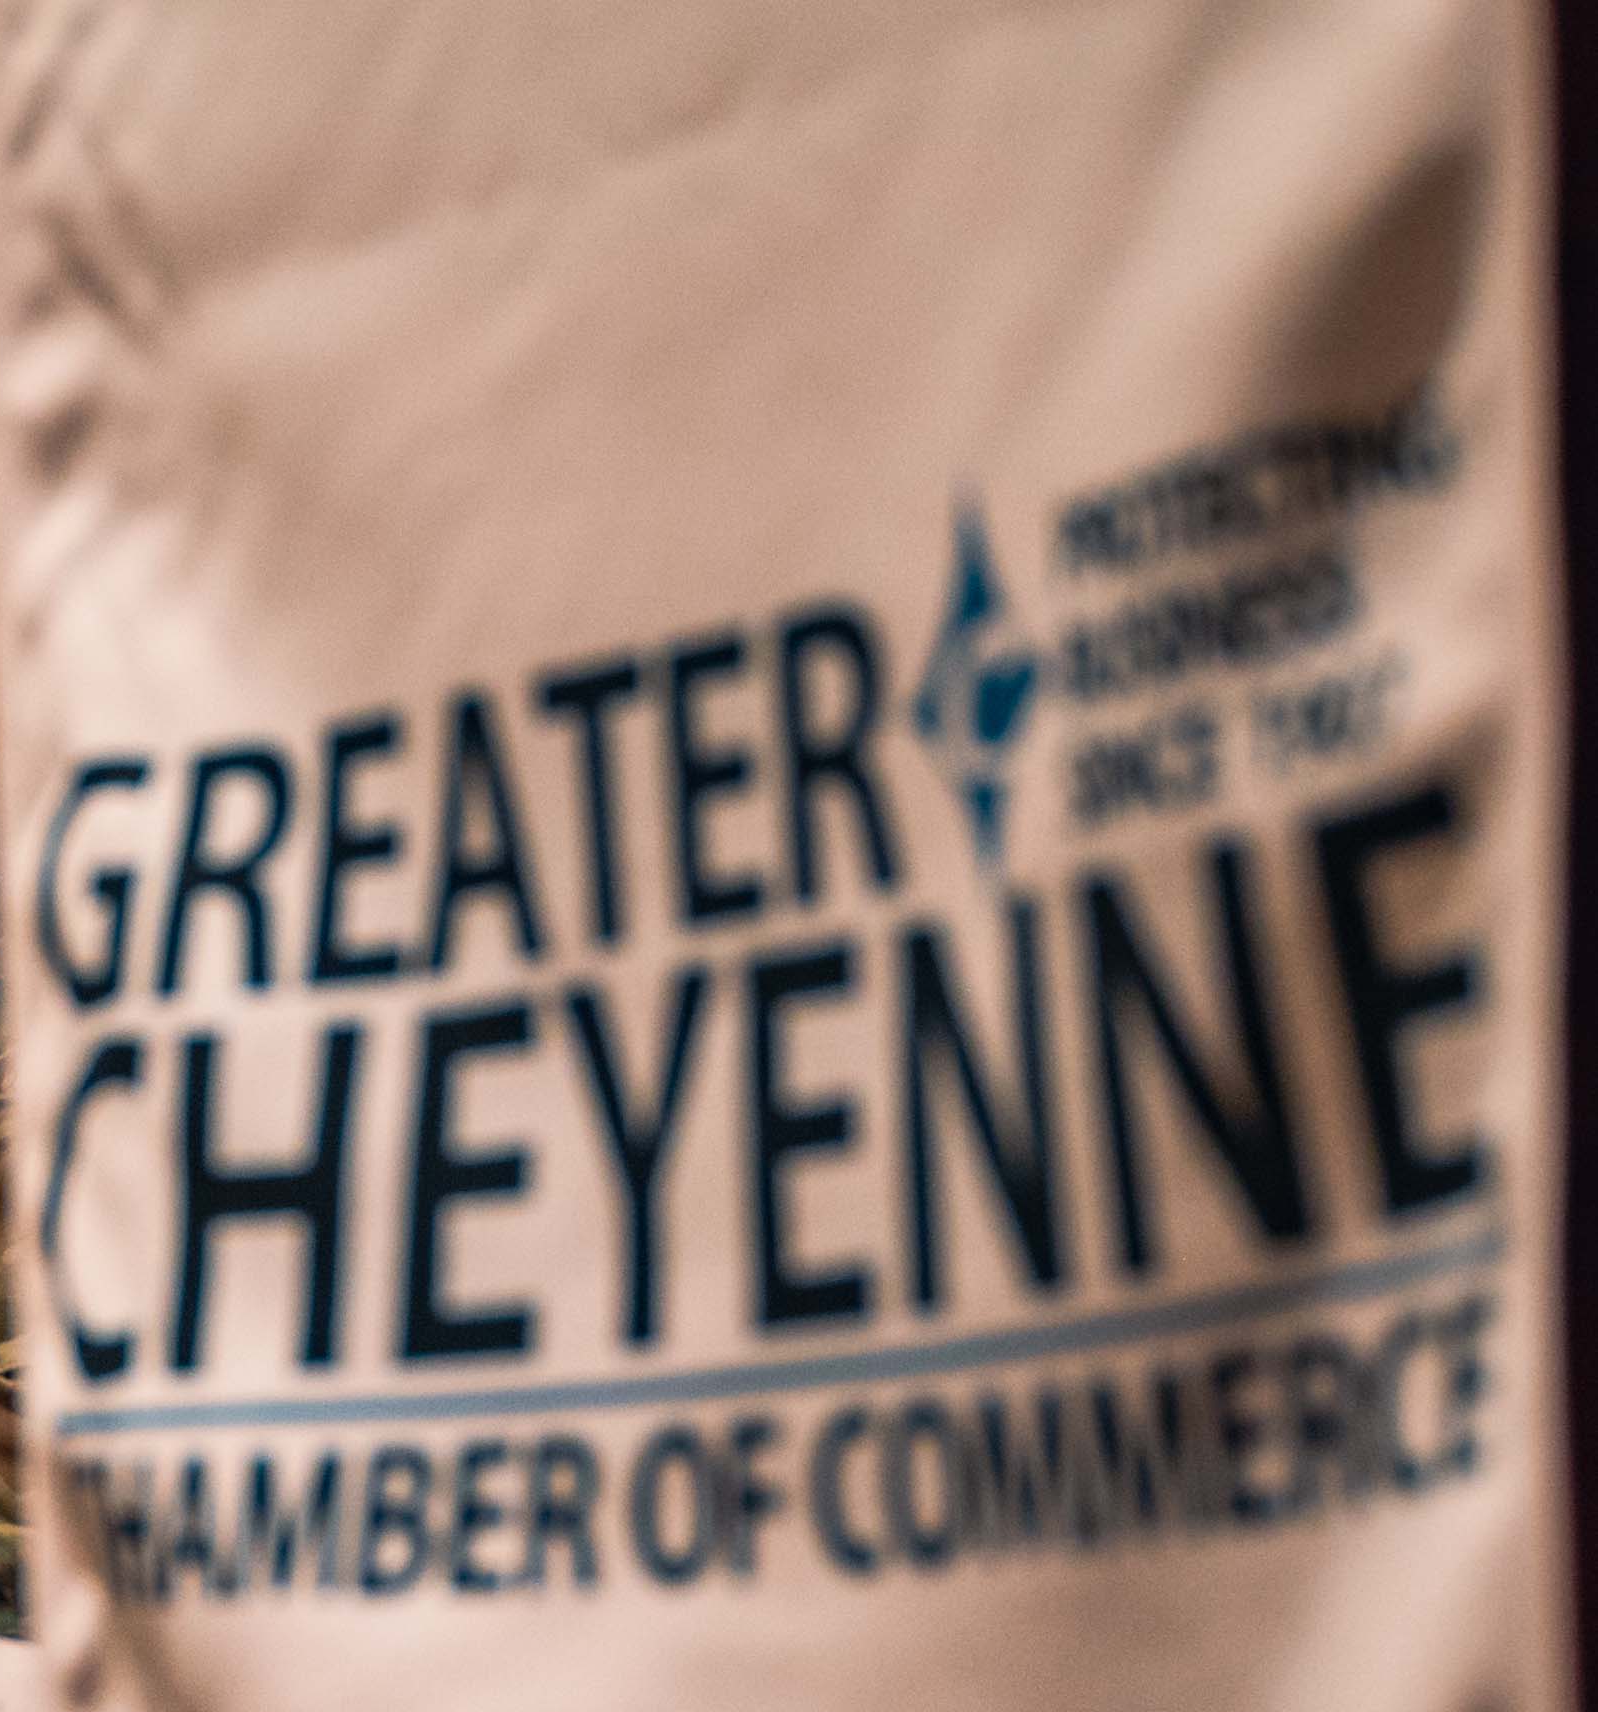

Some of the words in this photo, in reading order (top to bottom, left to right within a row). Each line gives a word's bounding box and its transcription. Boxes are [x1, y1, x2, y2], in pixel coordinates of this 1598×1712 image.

[33, 600, 901, 1010] GREATER
[39, 780, 1495, 1386] CHEYENNE
[65, 1436, 601, 1596] HAMBER
[630, 1414, 781, 1590] OF
